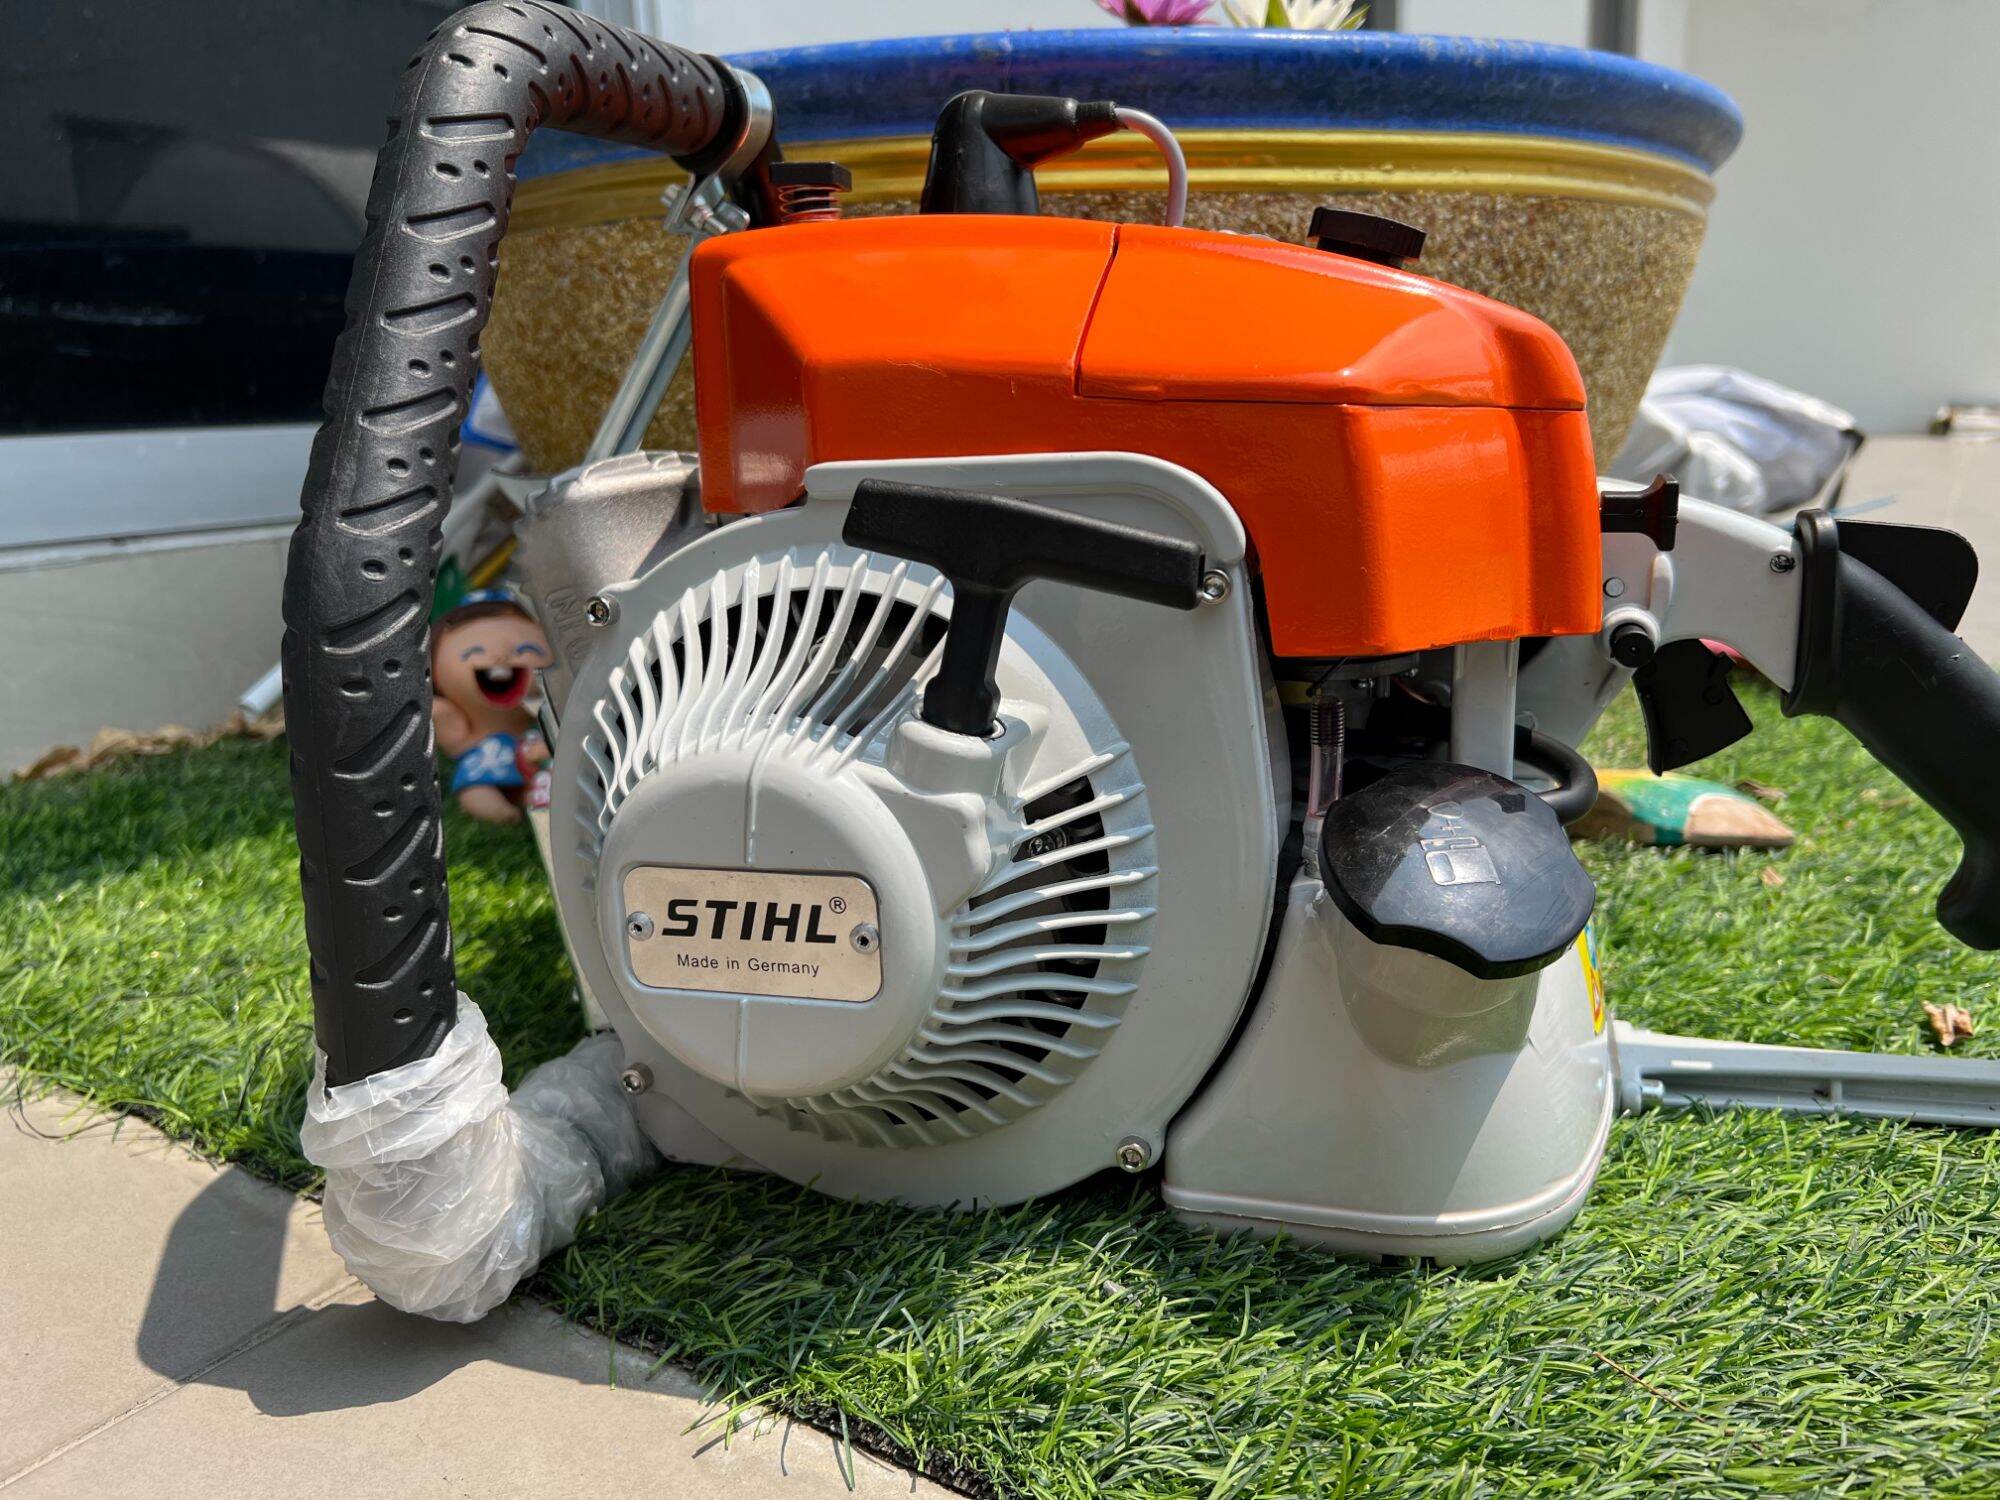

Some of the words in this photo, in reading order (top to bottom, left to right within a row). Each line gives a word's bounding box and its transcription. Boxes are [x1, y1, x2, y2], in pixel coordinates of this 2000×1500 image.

[677, 953, 719, 969] Made
[726, 956, 740, 970] in
[747, 958, 820, 978] Germany
